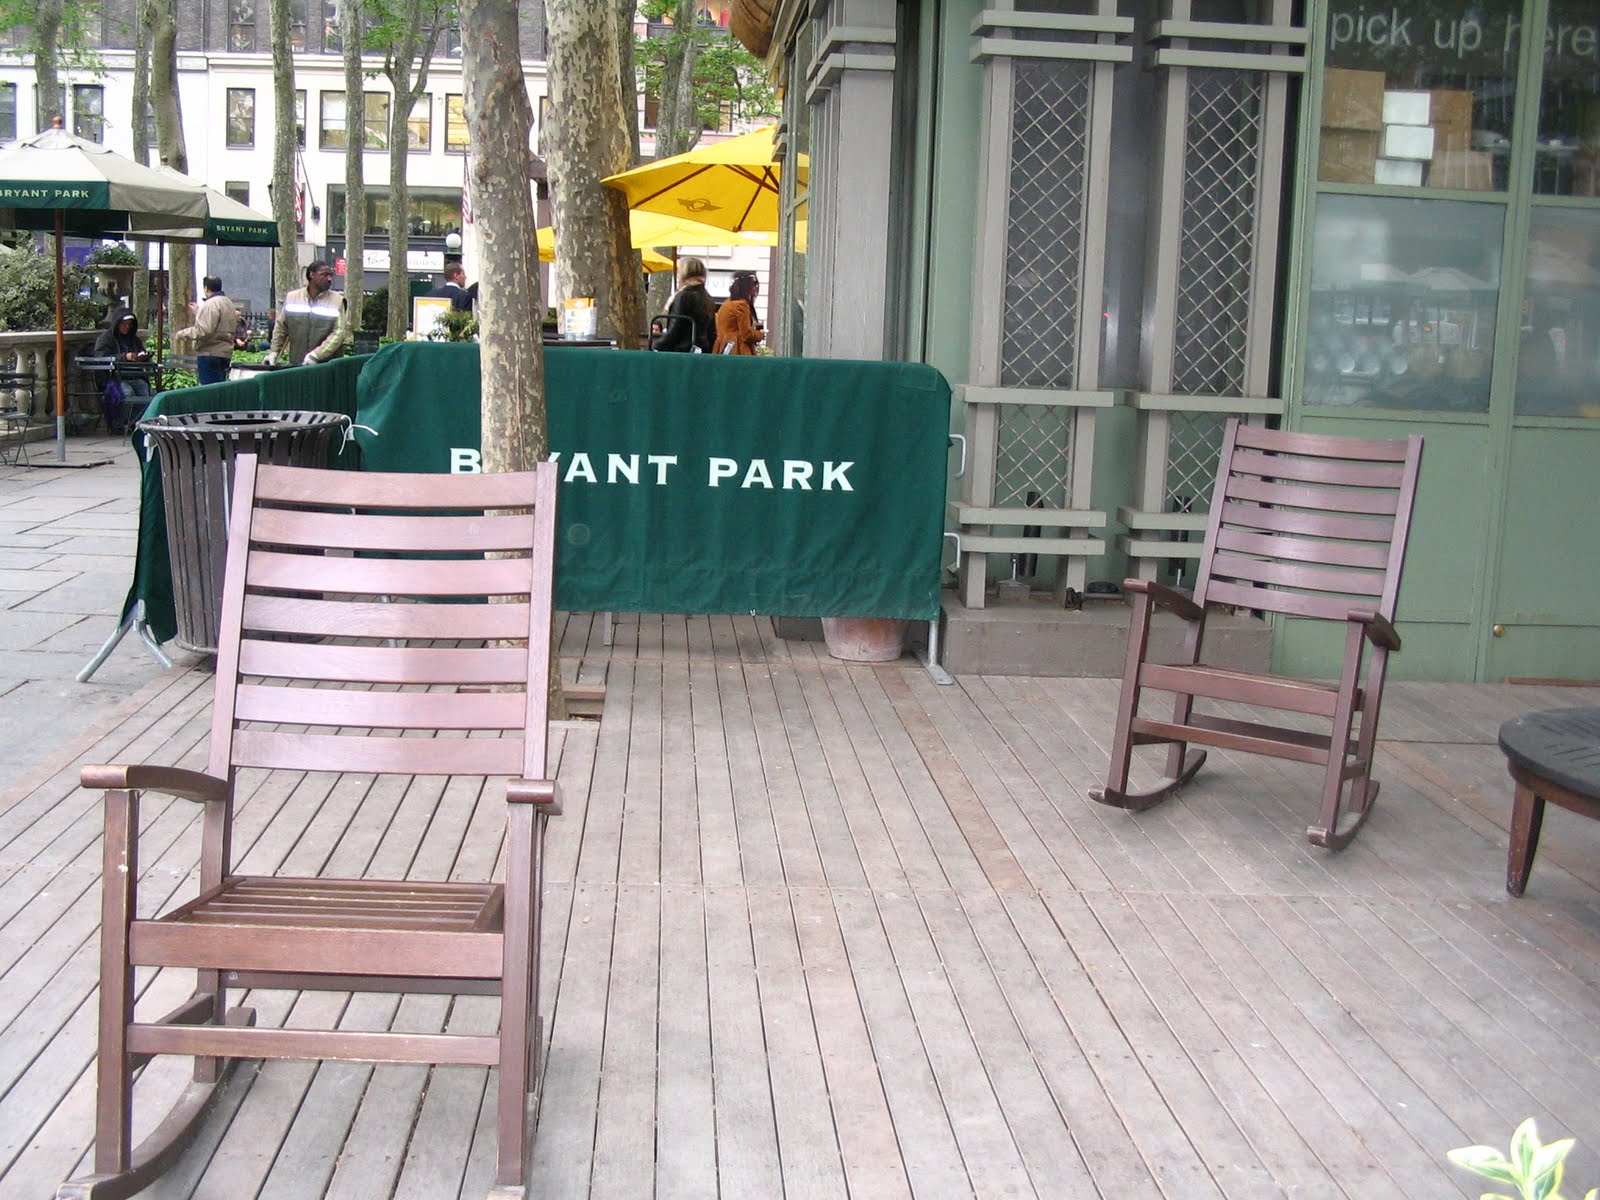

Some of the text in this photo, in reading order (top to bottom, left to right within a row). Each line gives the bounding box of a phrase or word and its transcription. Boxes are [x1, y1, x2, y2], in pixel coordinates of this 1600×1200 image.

[1329, 6, 1412, 51] pick
[1433, 16, 1483, 60] up
[54, 189, 89, 198] PARK
[216, 224, 268, 235] BRYANT PARK
[449, 447, 857, 493] BANT PARK
